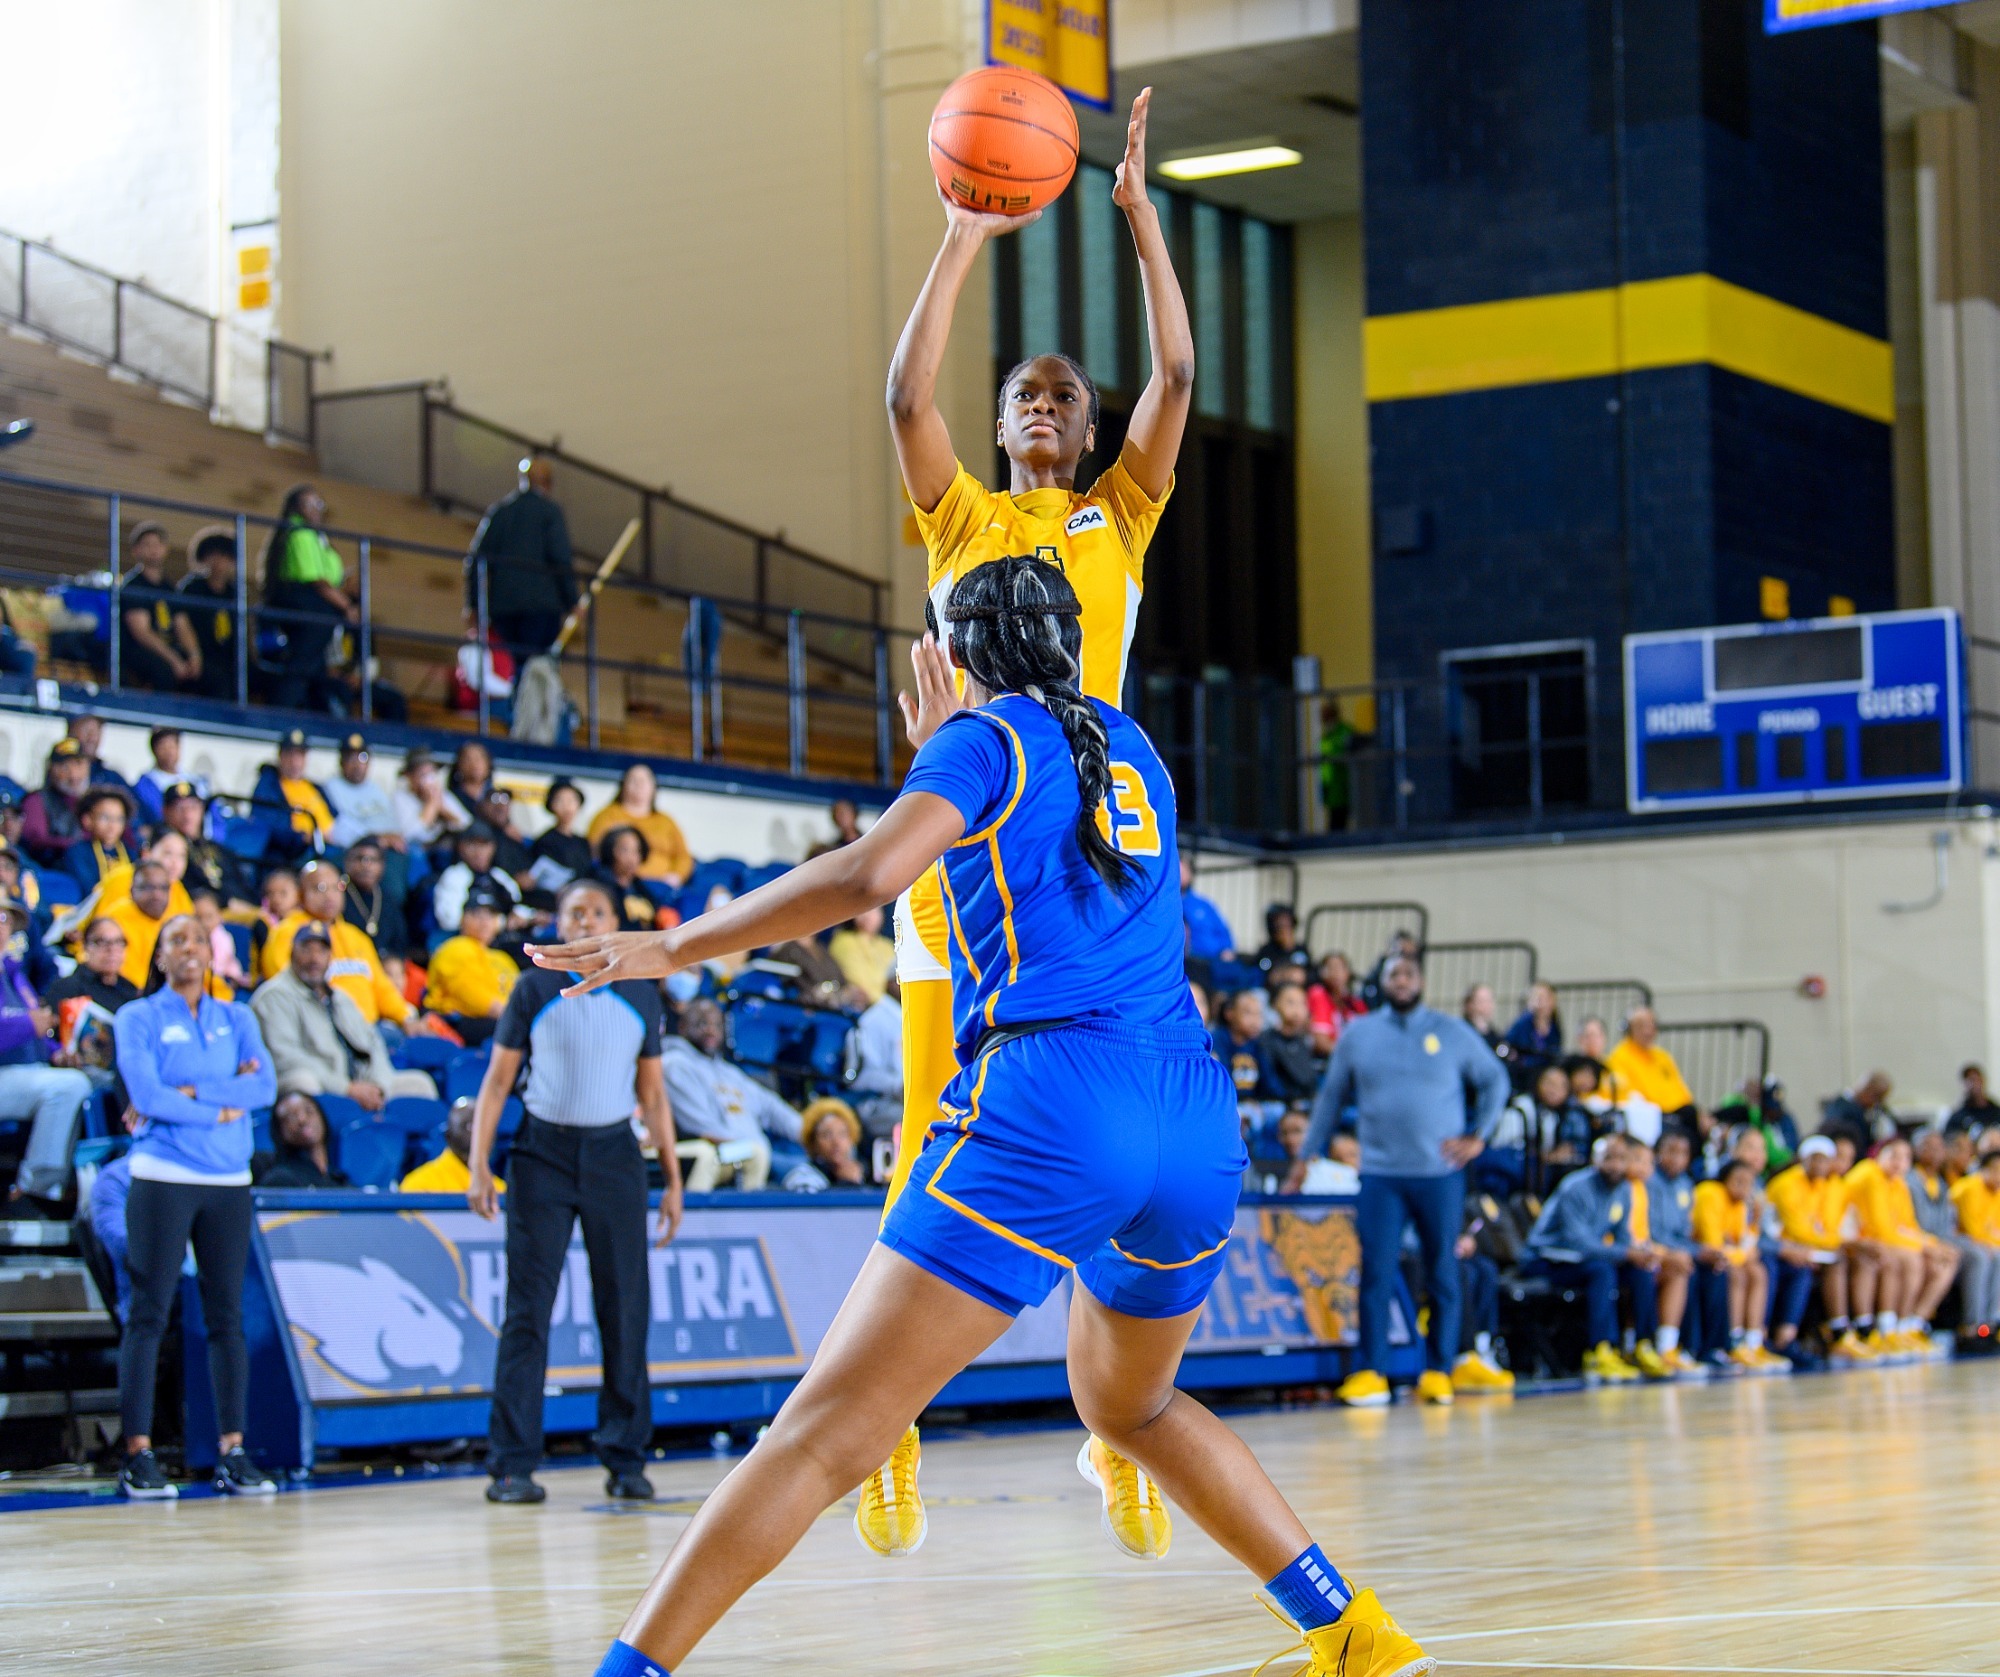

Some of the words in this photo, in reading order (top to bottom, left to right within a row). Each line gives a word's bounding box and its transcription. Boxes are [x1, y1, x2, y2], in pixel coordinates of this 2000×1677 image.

[1067, 511, 1103, 530] CAA
[1857, 682, 1939, 720] GUEST
[1645, 703, 1716, 735] HOME
[1093, 760, 1161, 857] 3
